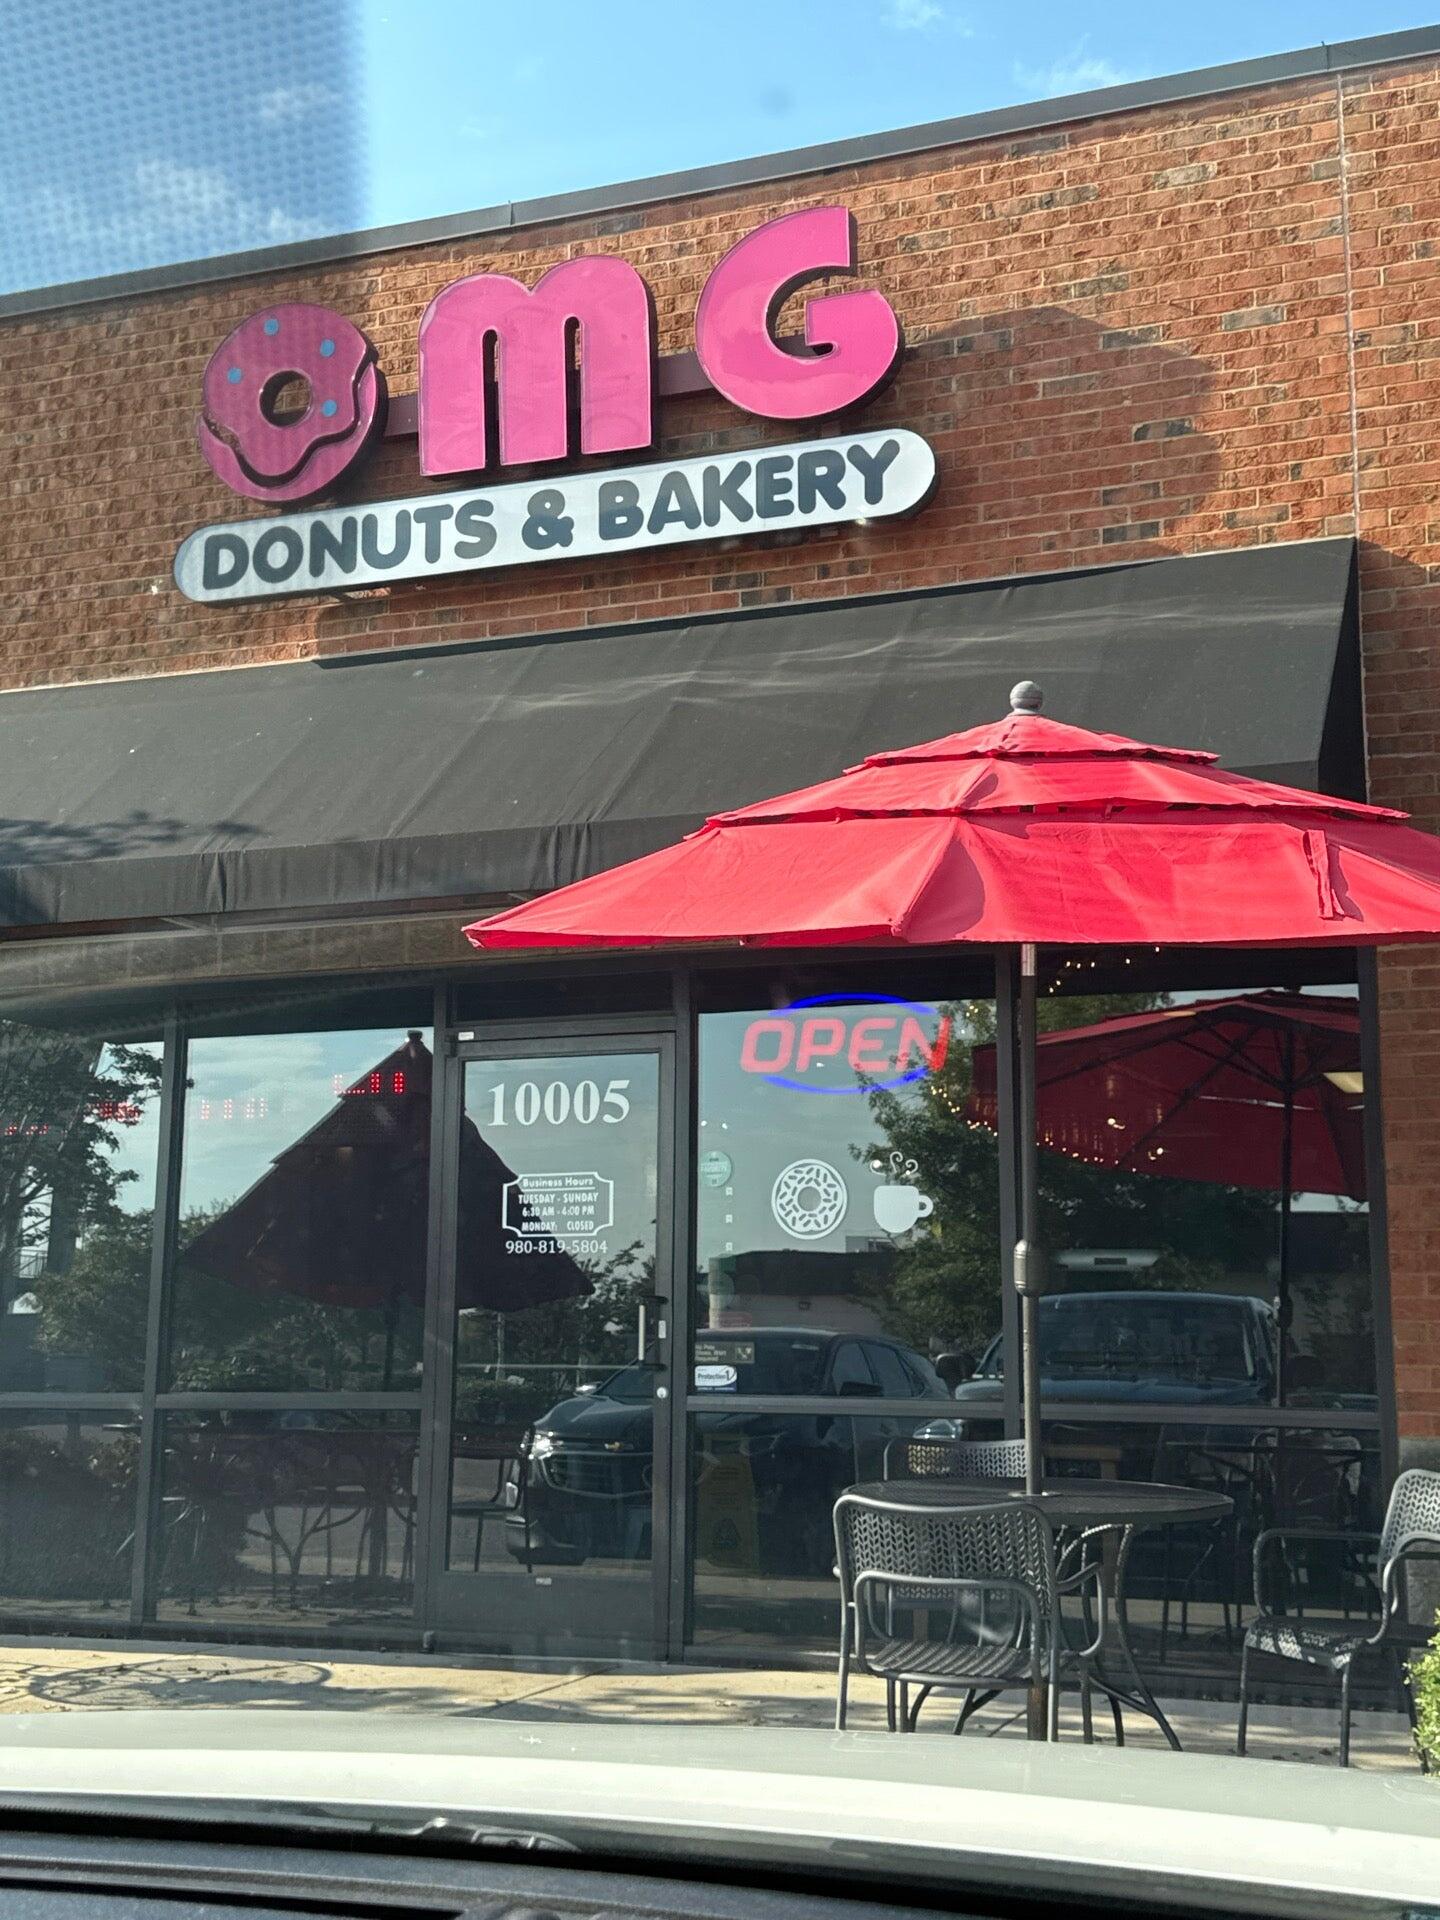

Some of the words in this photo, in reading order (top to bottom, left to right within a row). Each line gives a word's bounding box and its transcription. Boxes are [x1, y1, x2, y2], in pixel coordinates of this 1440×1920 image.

[203, 498, 497, 591] DONUTS
[522, 488, 574, 550] &
[599, 438, 901, 541] BAKERY
[740, 1016, 952, 1073] OPEN
[488, 1080, 630, 1126] 10005
[523, 1177, 563, 1188] Business
[565, 1176, 594, 1187] Hours
[518, 1193, 556, 1205] TUESDAY
[563, 1192, 599, 1203] SUNDAY
[522, 1206, 541, 1217] 6:30
[542, 1206, 555, 1216] AM
[561, 1205, 580, 1216] 4:00
[582, 1205, 595, 1215] PM
[567, 1220, 594, 1231] CLOSED
[505, 1240, 609, 1254] 980-819-5804
